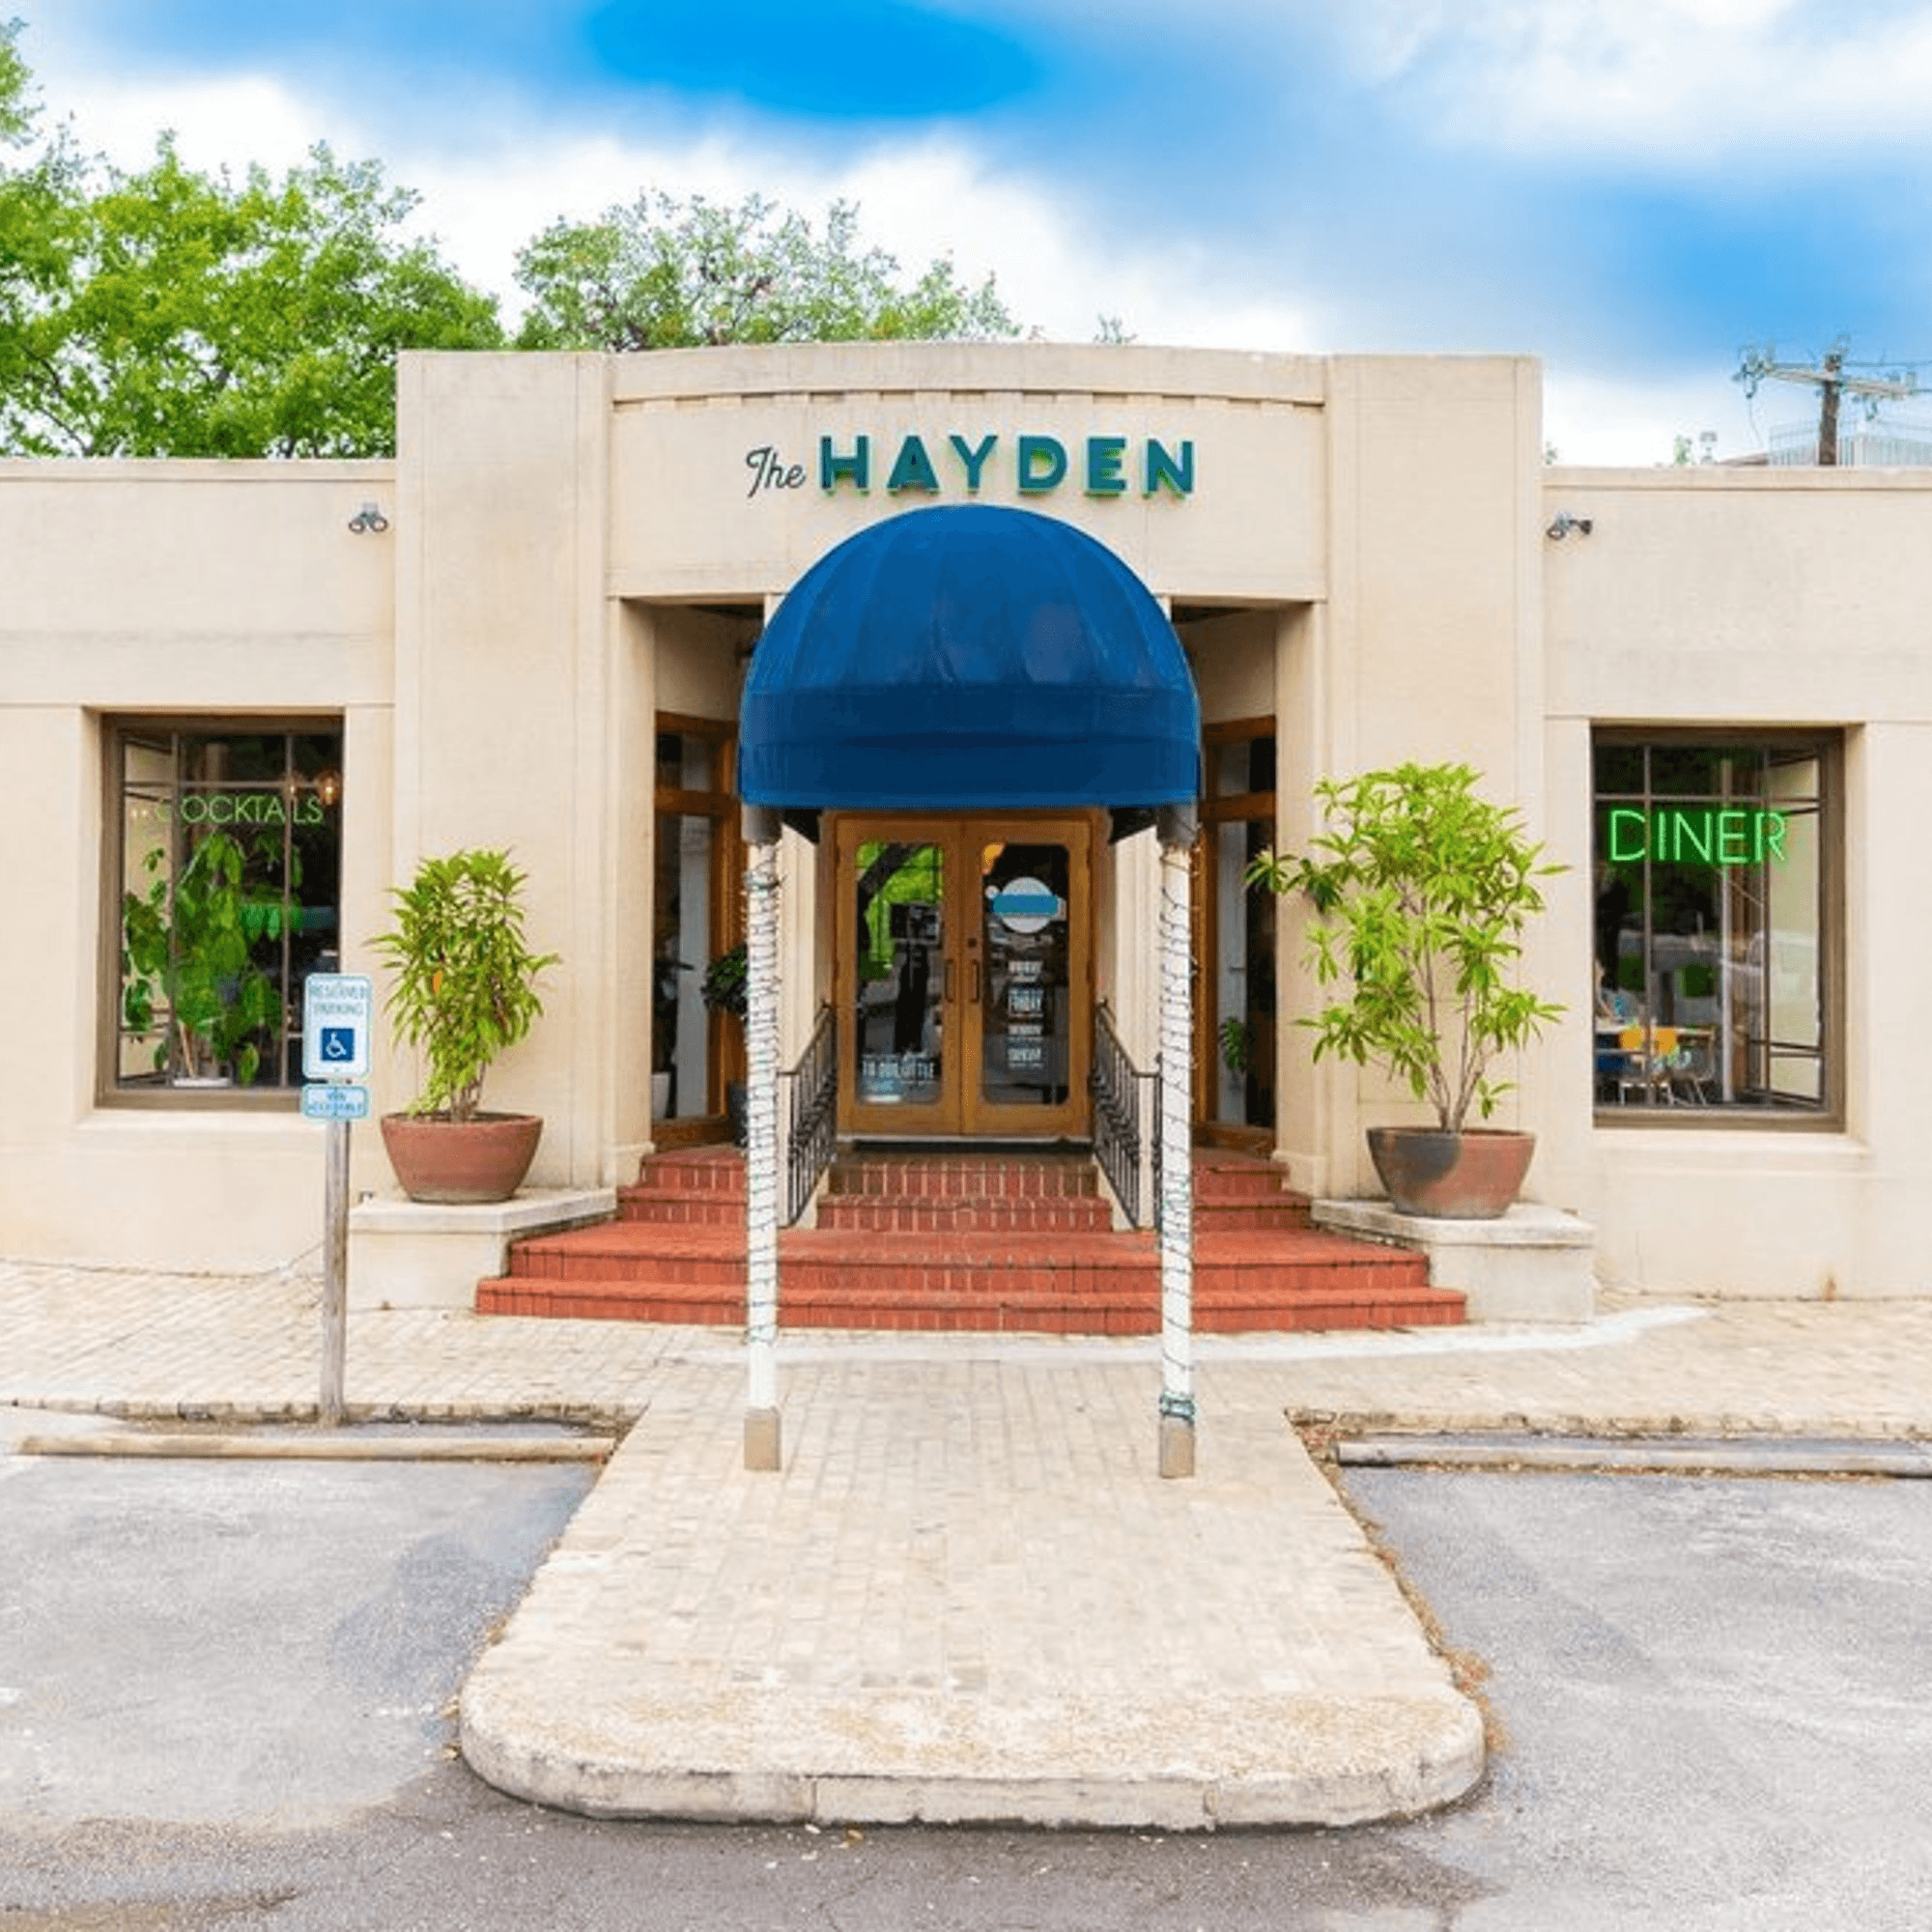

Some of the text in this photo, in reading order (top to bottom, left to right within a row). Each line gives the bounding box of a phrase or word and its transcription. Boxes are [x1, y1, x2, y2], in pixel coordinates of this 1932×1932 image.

[745, 434, 1196, 498] The HAYDEN
[1608, 809, 1786, 864] DINER
